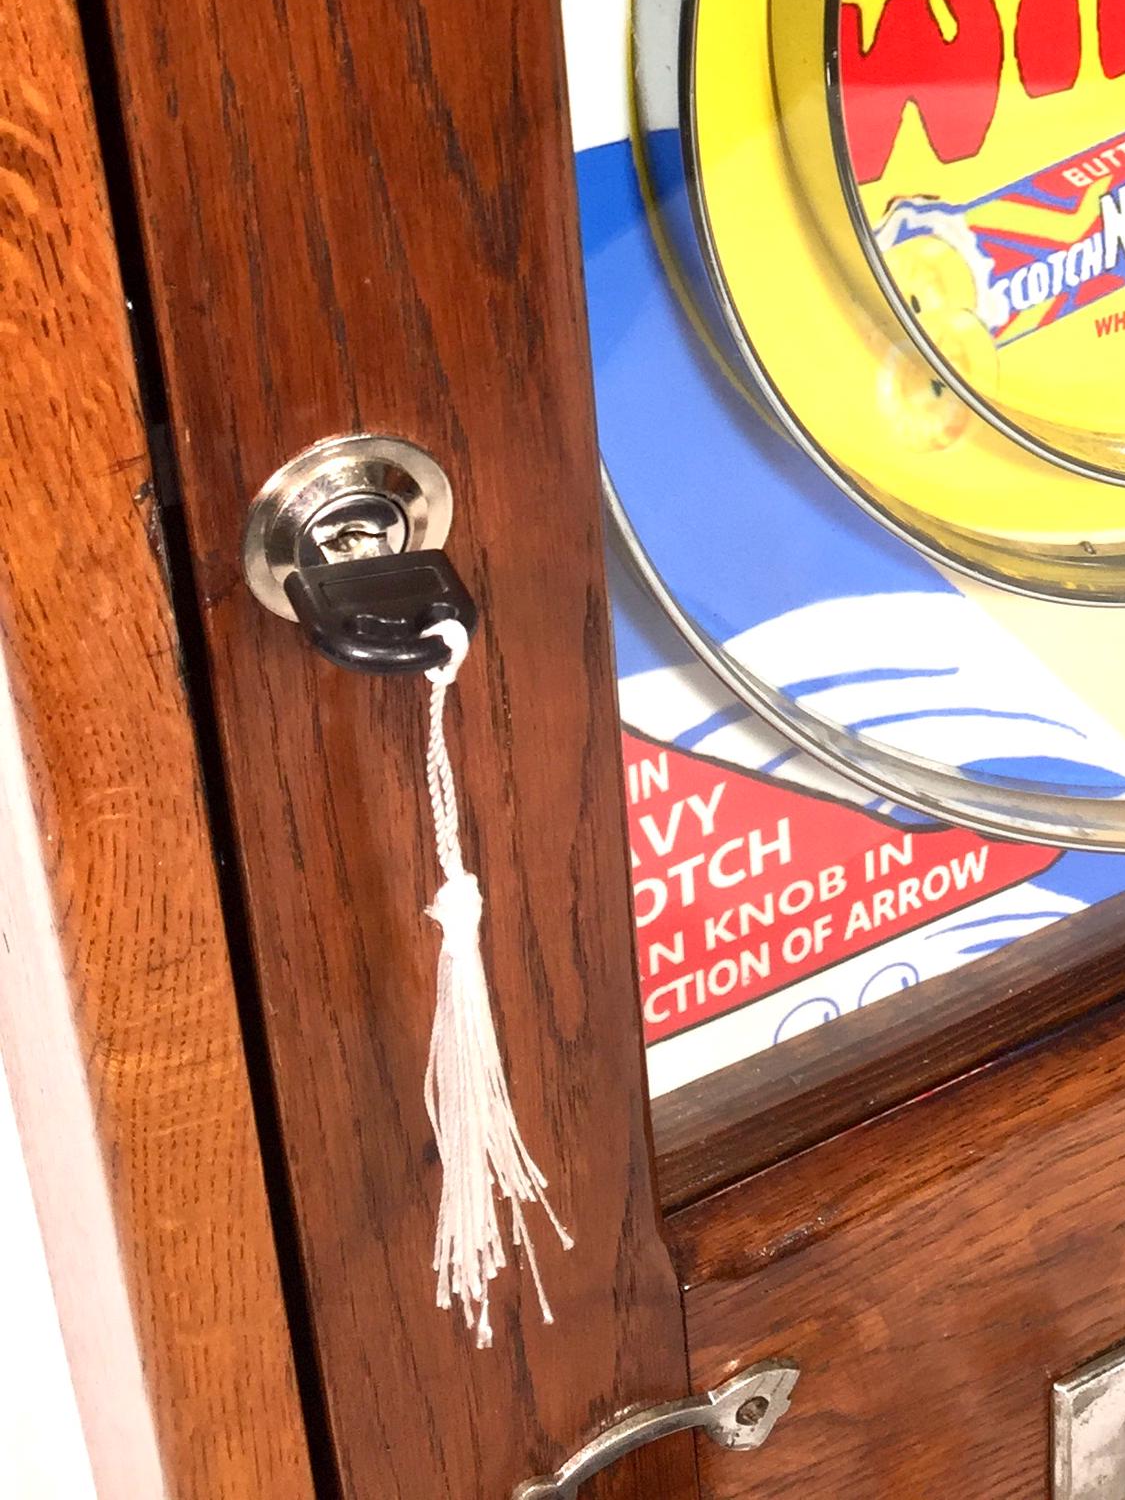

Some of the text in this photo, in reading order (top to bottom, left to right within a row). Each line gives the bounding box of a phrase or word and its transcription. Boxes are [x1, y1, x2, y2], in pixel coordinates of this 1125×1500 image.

[991, 233, 1104, 326] SCOTCH
[628, 752, 669, 804] IN
[634, 817, 791, 928] OTCH
[705, 833, 913, 951] KNOB IN
[643, 942, 771, 1023] CTION
[782, 914, 833, 963] OF
[844, 846, 989, 941] ARROW
